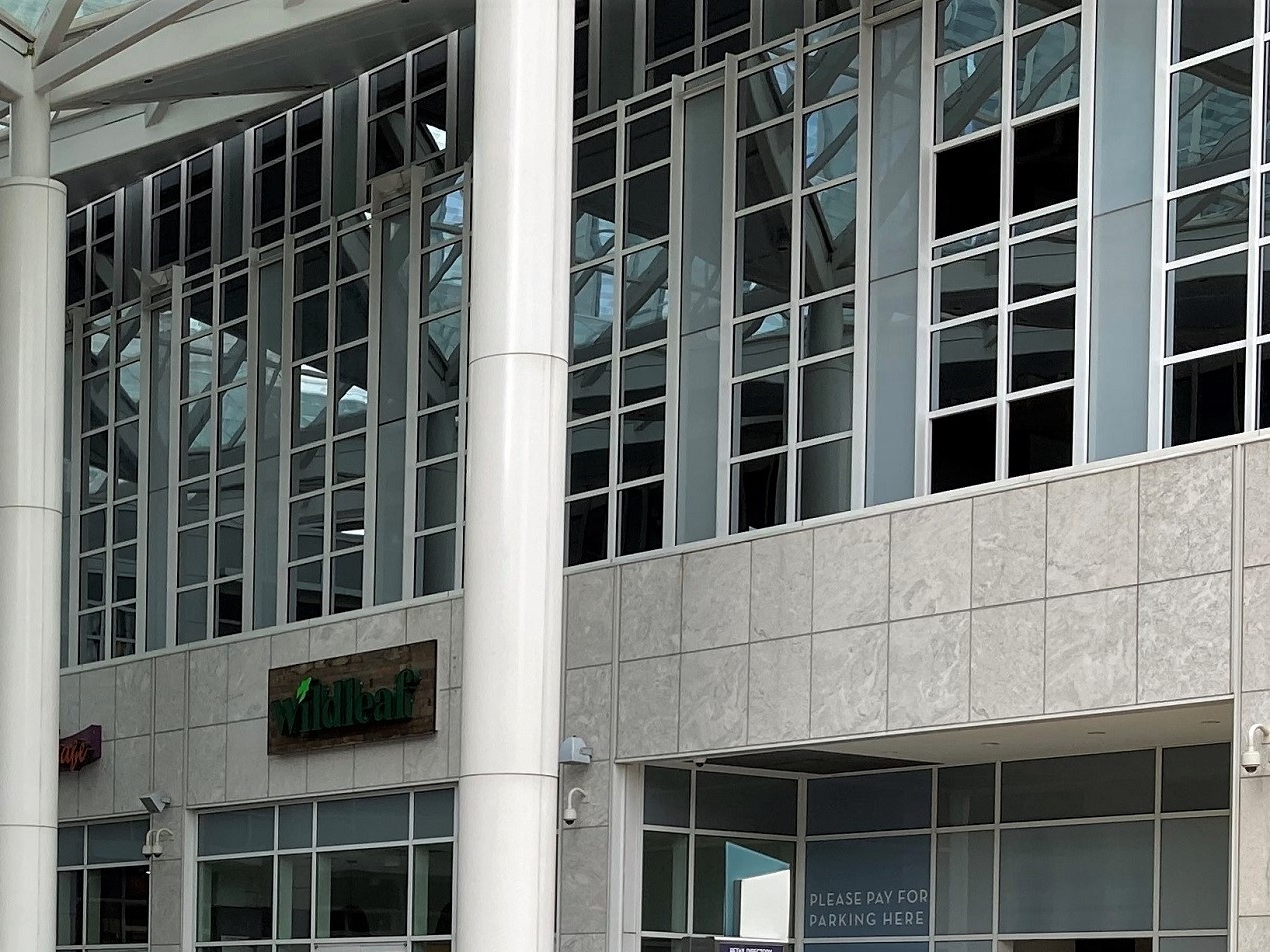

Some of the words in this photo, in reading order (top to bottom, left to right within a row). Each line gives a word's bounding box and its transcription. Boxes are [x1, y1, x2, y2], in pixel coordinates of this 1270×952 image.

[810, 891, 862, 907] PLEASE
[866, 890, 893, 905] PAY
[897, 889, 928, 904] FOR
[809, 912, 876, 927] PARKING
[882, 911, 924, 926] HERE
